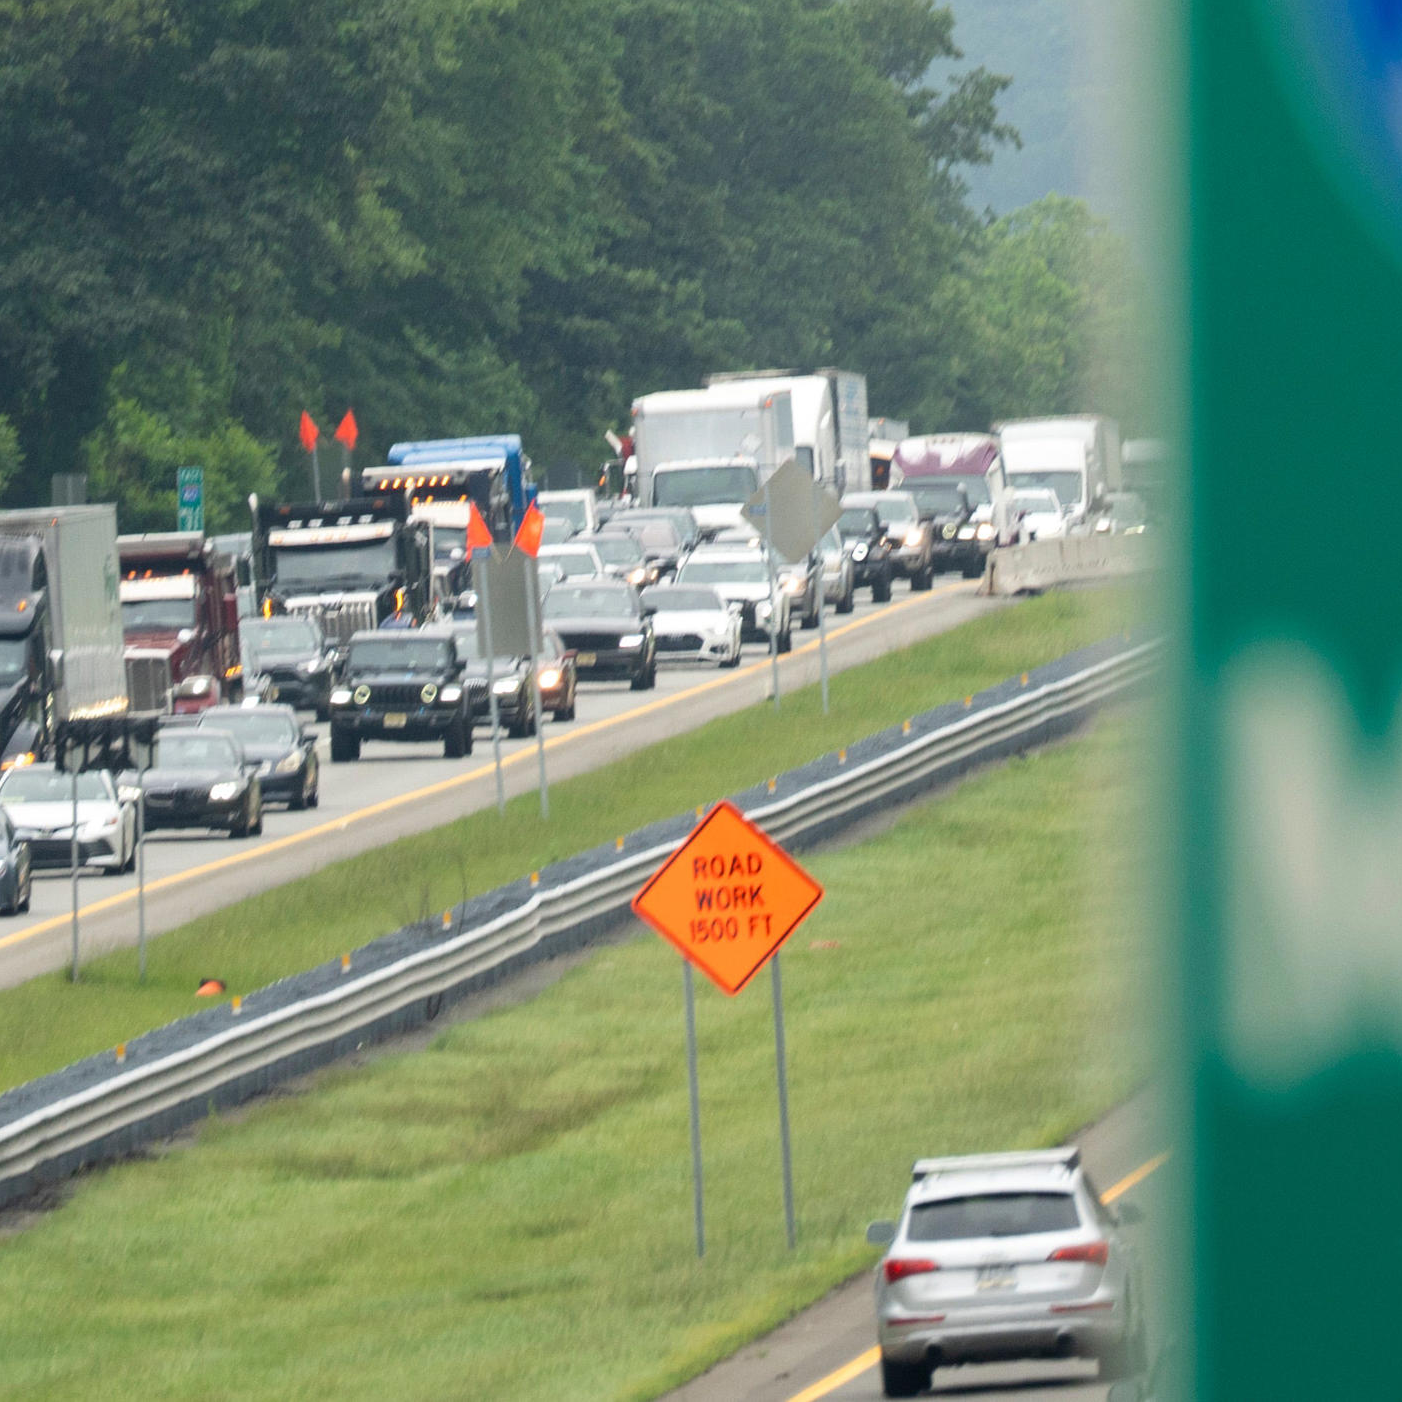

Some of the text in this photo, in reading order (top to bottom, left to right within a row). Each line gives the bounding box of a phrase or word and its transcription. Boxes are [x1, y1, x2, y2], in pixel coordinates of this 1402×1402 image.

[693, 852, 762, 880] ROAD
[695, 883, 764, 911] WORK
[690, 914, 772, 943] 1500 FT
